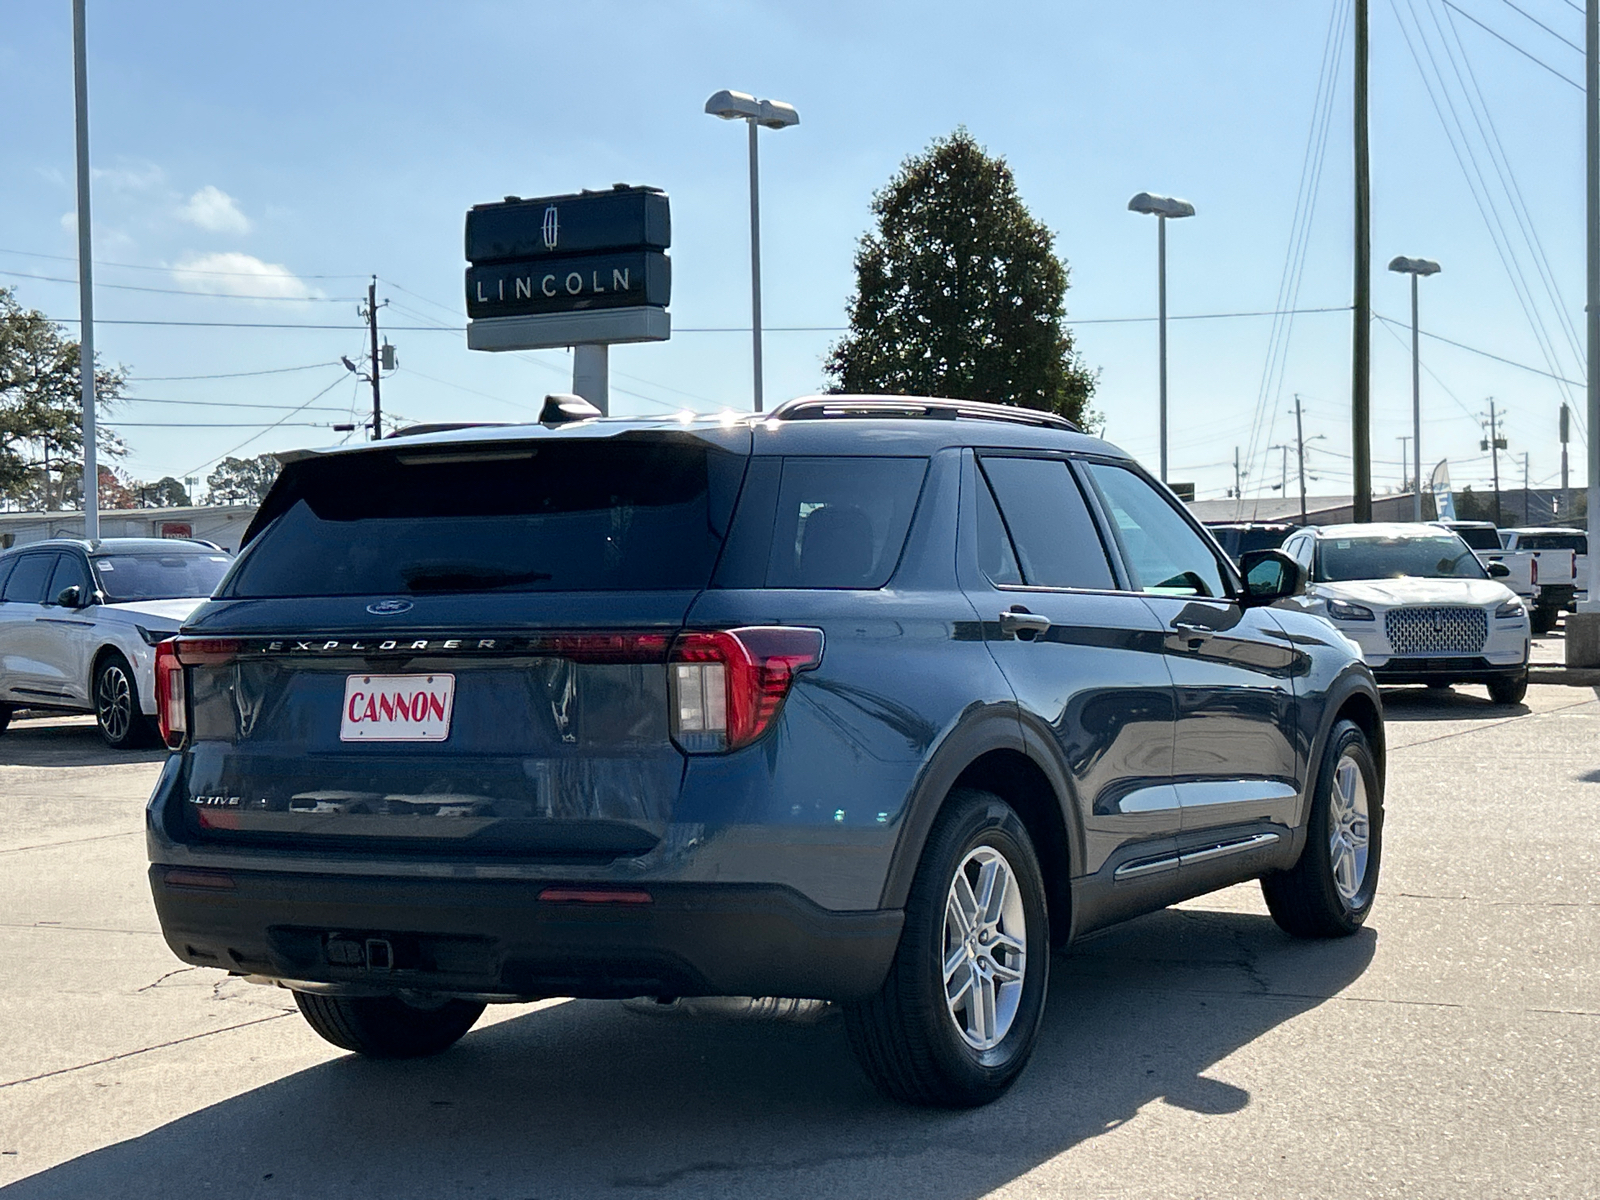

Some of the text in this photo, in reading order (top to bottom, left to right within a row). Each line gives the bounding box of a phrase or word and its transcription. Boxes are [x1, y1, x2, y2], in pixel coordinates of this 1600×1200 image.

[477, 268, 629, 302] LINCOLN
[268, 639, 496, 650] EXPLORER
[348, 691, 447, 723] CANNON
[189, 795, 240, 805] ACTIVE
